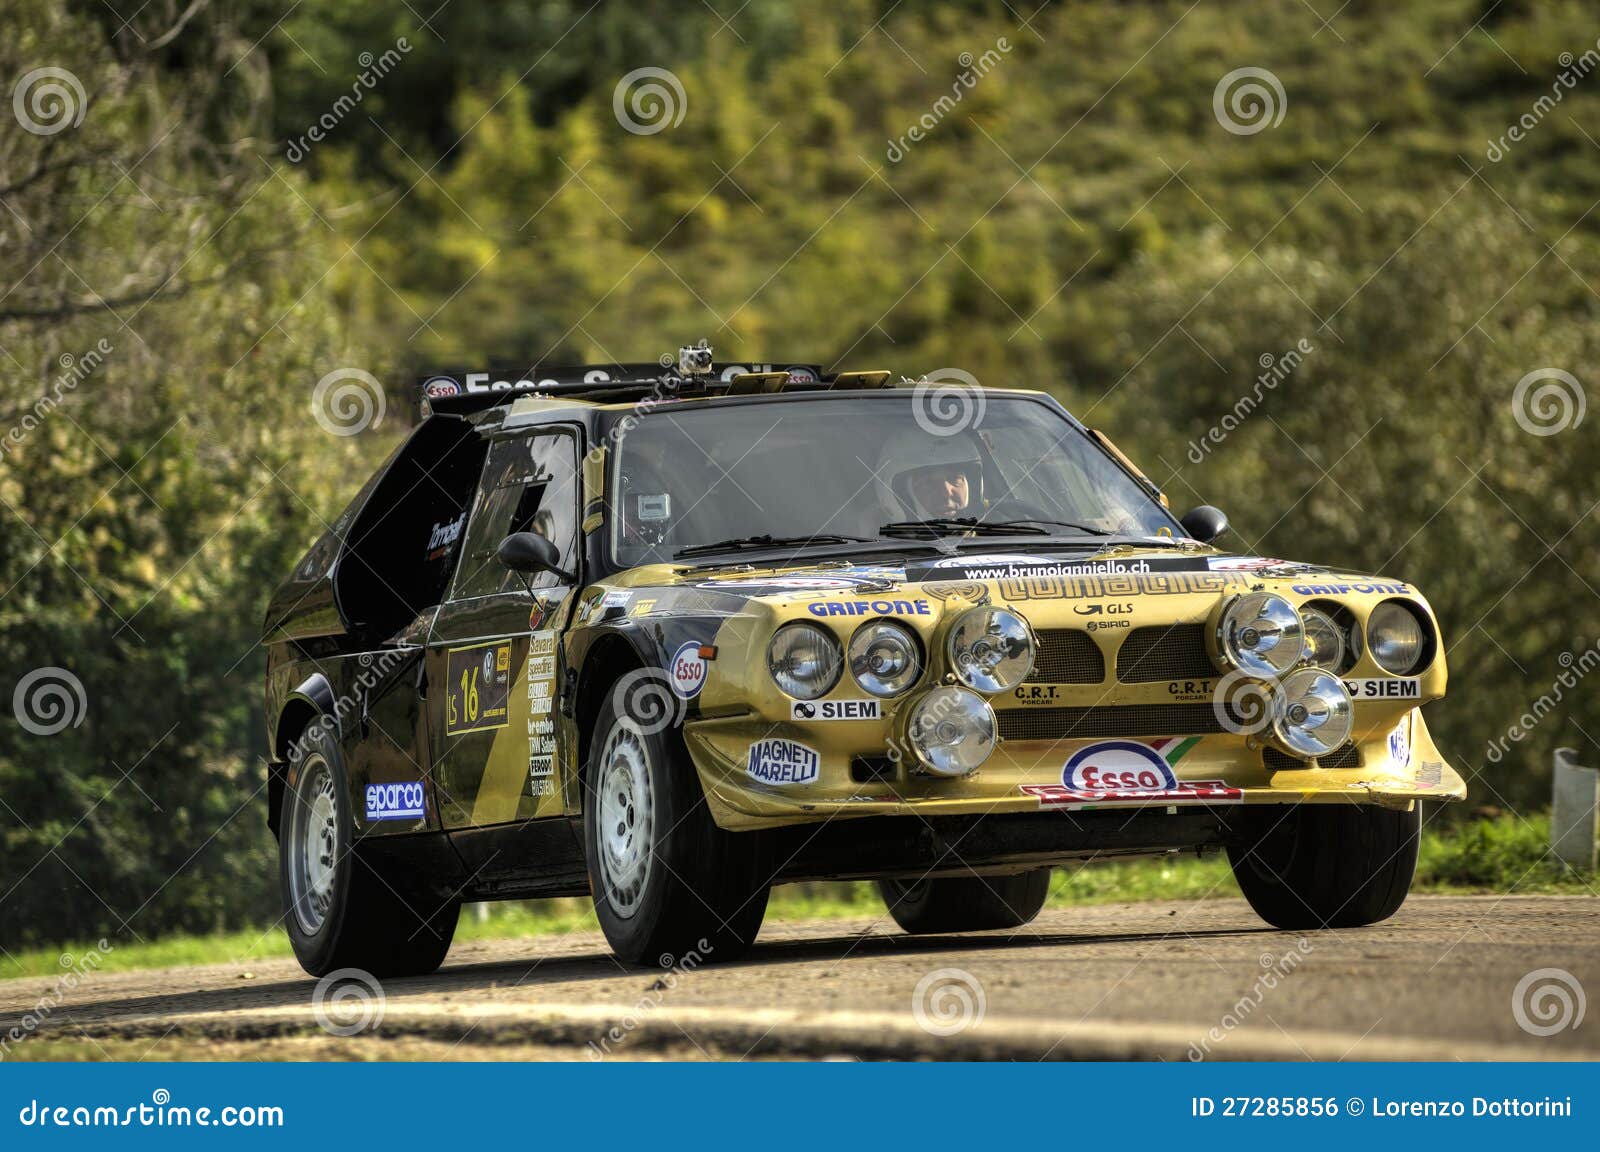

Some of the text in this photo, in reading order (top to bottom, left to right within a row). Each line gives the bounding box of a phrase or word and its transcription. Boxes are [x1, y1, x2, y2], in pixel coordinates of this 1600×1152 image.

[964, 559, 1150, 580] www.brunoianniello.ch
[1291, 583, 1411, 596] GRIFONE
[808, 599, 931, 617] GRIFONE
[1106, 603, 1133, 614] GLS
[1098, 620, 1130, 629] SIRIO
[460, 666, 479, 723] 16
[1014, 686, 1060, 699] C.R.T.
[1168, 681, 1213, 694] C.R.T.
[1365, 680, 1417, 697] SIEM
[822, 702, 877, 718] SIEM
[527, 717, 554, 735] brembo
[749, 740, 817, 768] MAGNETI
[749, 757, 817, 782] MARELLI
[366, 782, 424, 819] sparco
